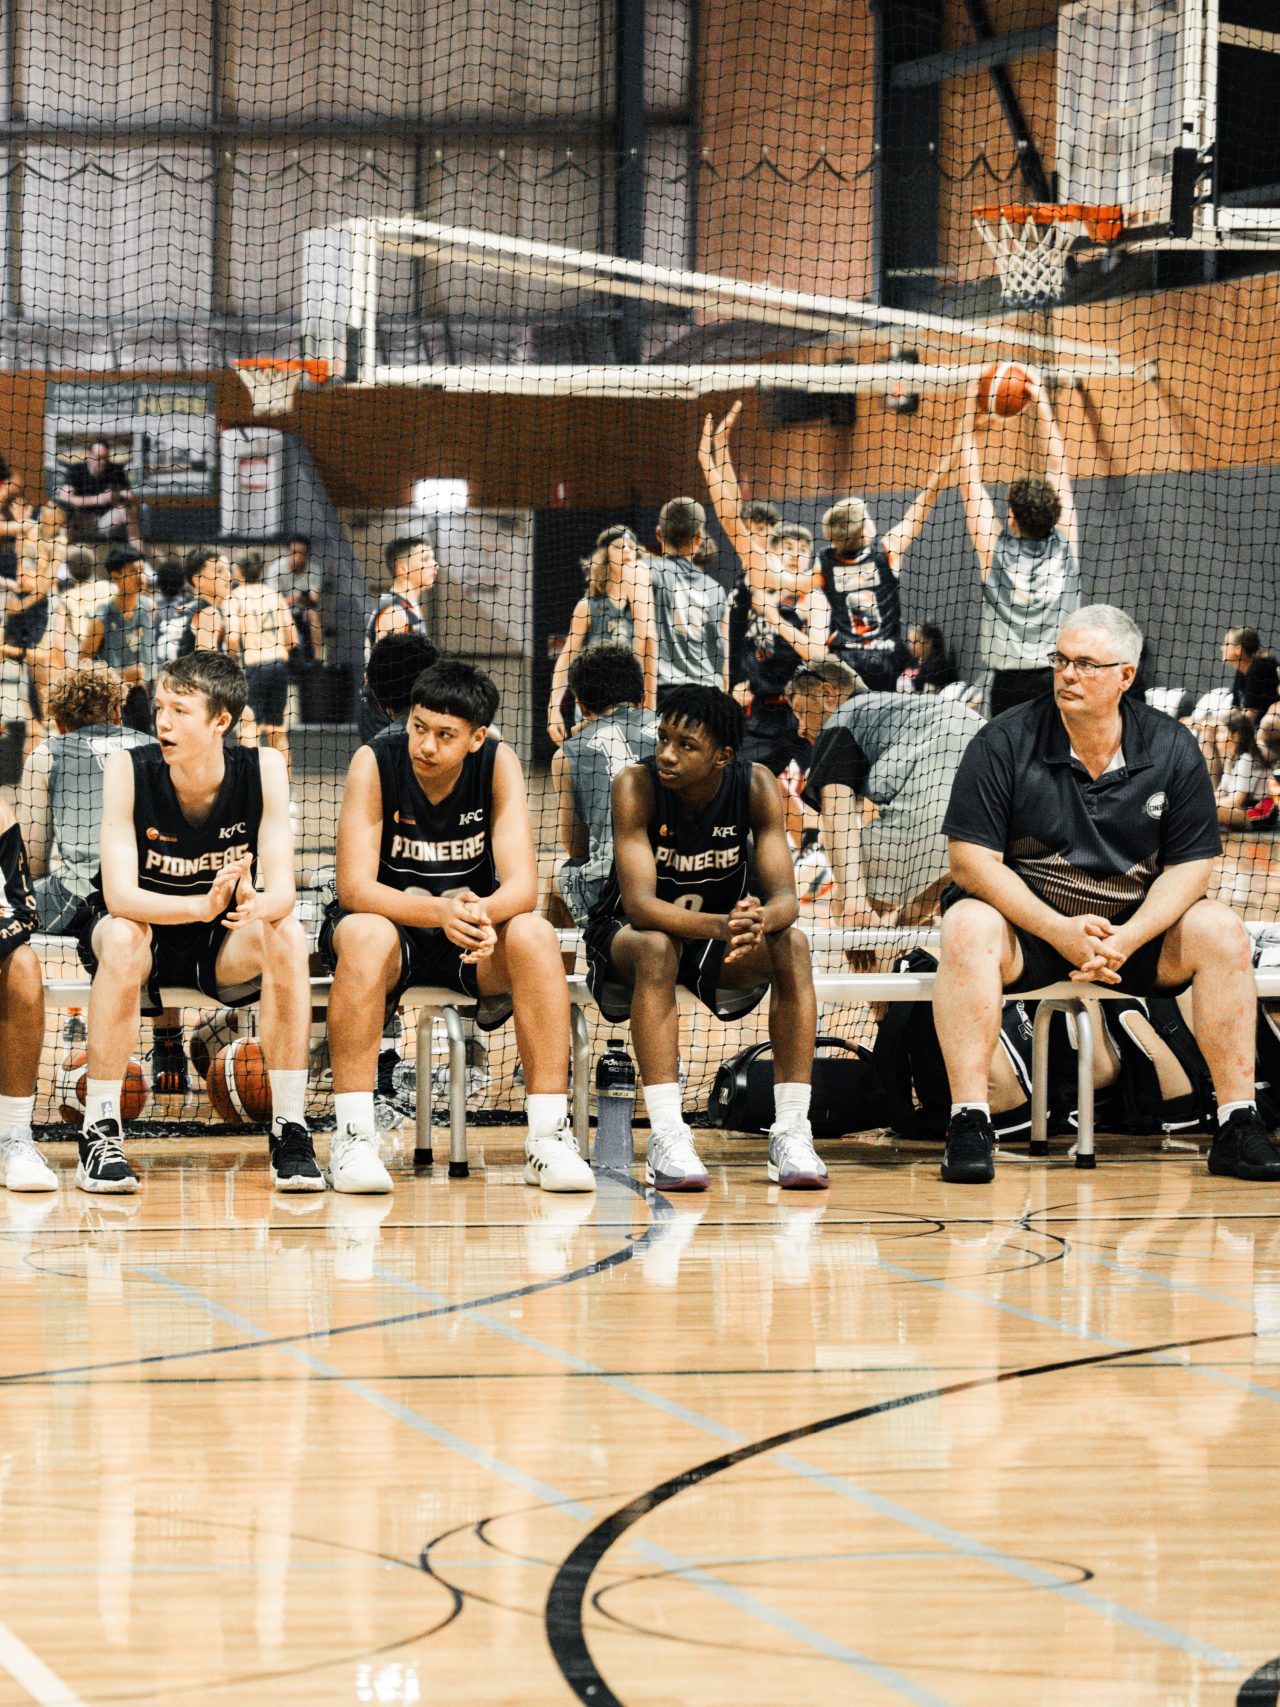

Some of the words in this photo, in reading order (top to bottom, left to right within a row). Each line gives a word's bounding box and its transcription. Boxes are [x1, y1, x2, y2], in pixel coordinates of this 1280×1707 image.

[459, 808, 484, 825] KFC
[712, 825, 738, 838] KFC
[391, 831, 485, 861] PIONEERS
